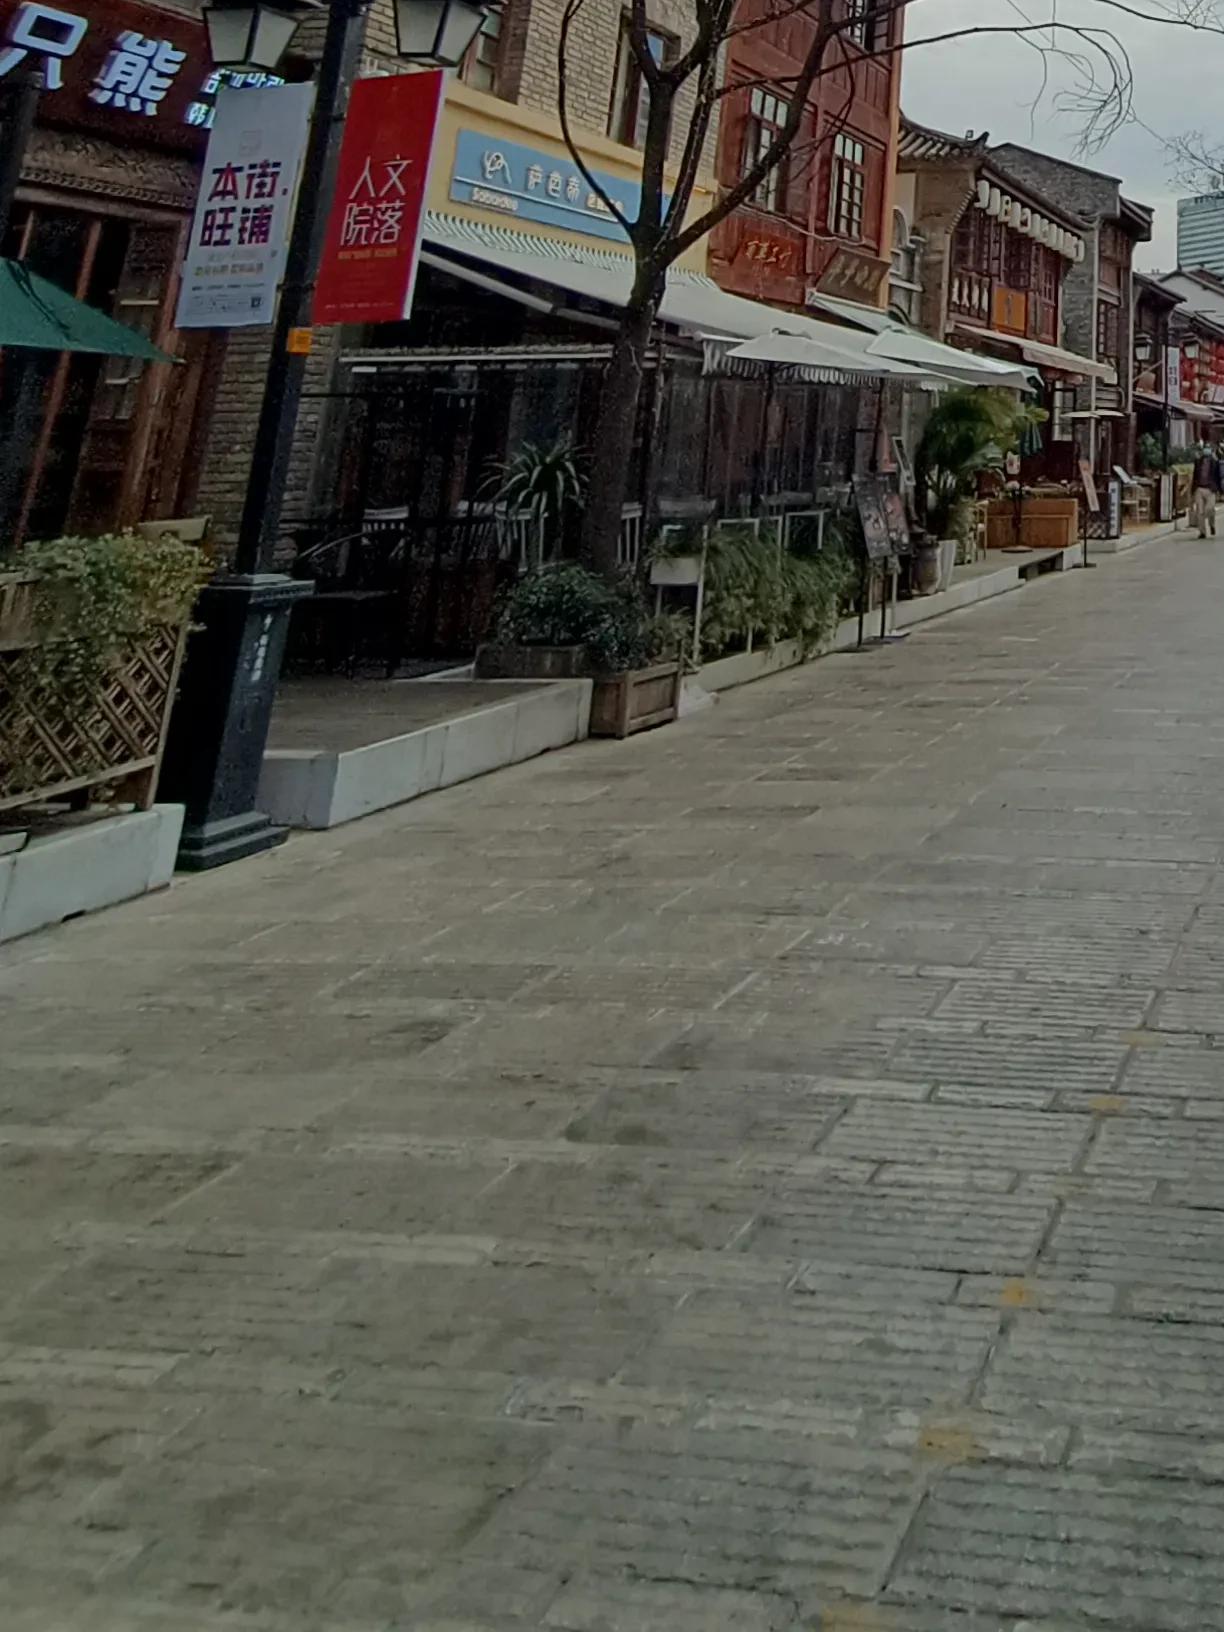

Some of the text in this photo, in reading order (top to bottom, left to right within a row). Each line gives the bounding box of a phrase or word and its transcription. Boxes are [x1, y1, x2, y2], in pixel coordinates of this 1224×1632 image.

[208, 159, 282, 202] 本街
[349, 155, 413, 200] 人文
[199, 204, 274, 247] 旺铺
[340, 200, 405, 246] 院落
